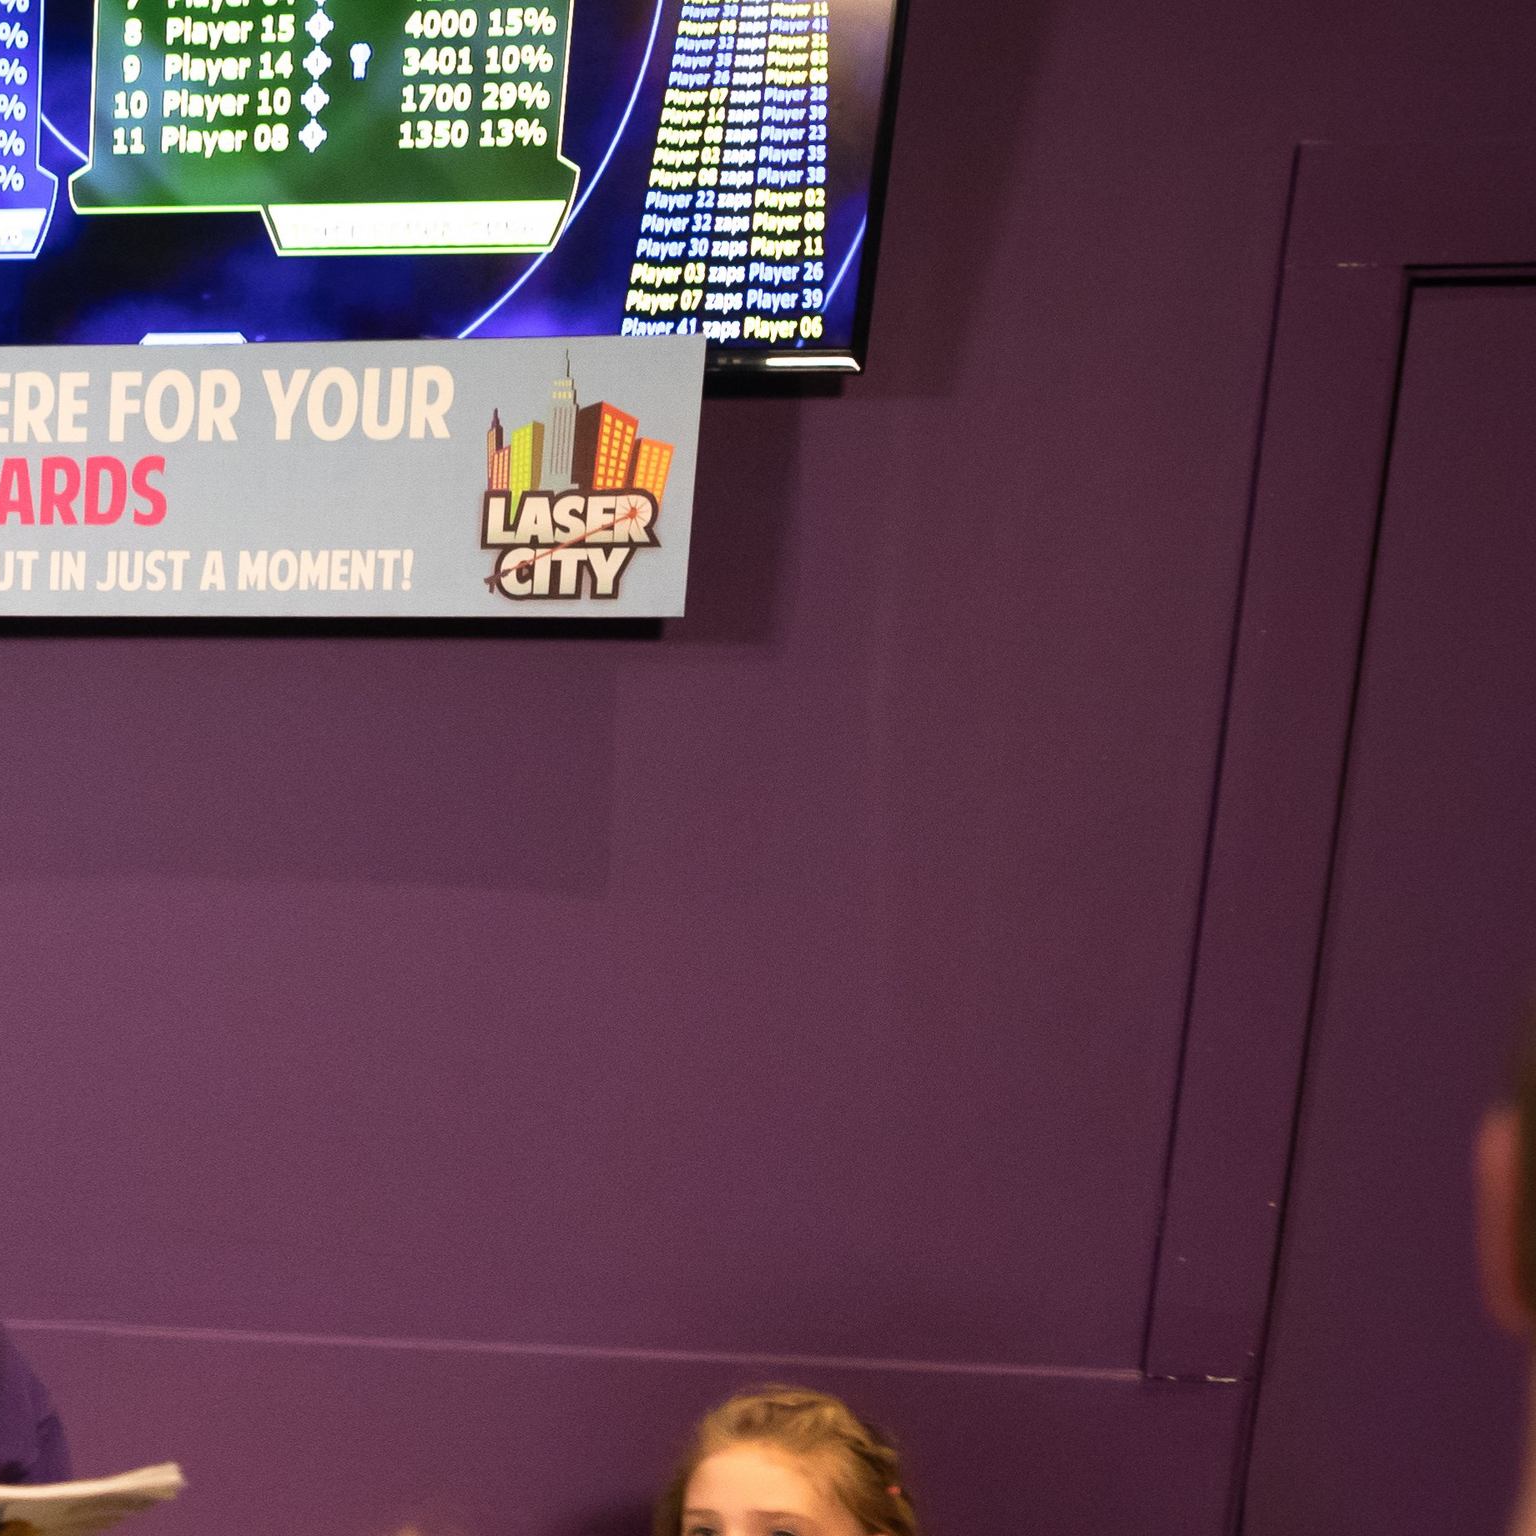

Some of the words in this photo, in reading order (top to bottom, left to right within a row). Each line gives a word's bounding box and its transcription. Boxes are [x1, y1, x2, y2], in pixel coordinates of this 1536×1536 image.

[125, 18, 141, 46] 8
[167, 16, 253, 50] Player
[261, 14, 294, 42] 15
[405, 9, 477, 38] 4000
[489, 8, 556, 36] 15%
[123, 55, 140, 83] 9
[165, 53, 251, 86] Player
[260, 51, 293, 79] 14
[403, 47, 472, 75] 3401
[486, 45, 553, 73] 10%
[115, 91, 147, 118] 10
[164, 89, 249, 122] Player
[258, 87, 290, 115] 10
[402, 83, 471, 112] 1700
[482, 82, 549, 110] 29%
[665, 89, 708, 108] Player
[710, 88, 728, 104] 07
[764, 87, 807, 104] Player
[661, 108, 705, 127] Player
[708, 107, 725, 123] 14
[763, 106, 806, 124] Player
[113, 127, 145, 154] 11
[162, 125, 247, 158] Player
[255, 124, 288, 151] 08
[399, 120, 468, 148] 1350
[480, 119, 547, 146] 13%
[657, 127, 702, 147] Player
[761, 126, 805, 144] Player
[809, 125, 826, 140] 23
[653, 147, 699, 168] Player
[701, 147, 720, 164] 02
[759, 146, 804, 165] Player
[808, 145, 826, 161] 35
[649, 168, 696, 190] Player
[758, 167, 803, 187] Player
[807, 167, 825, 183] 38
[646, 191, 692, 211] Player
[696, 191, 714, 207] 22
[717, 193, 752, 211] zaps
[755, 189, 803, 211] Player
[805, 188, 825, 207] 02
[641, 214, 689, 235] Player
[692, 214, 711, 231] 32
[714, 216, 749, 235] zaps
[753, 212, 802, 235] Player
[804, 211, 824, 231] 08
[637, 238, 686, 261] Player
[688, 238, 708, 256] 30
[712, 241, 747, 261] zaps
[751, 236, 801, 260] Player
[804, 236, 823, 255] 11
[631, 263, 682, 288] Player
[684, 263, 705, 283] 03
[708, 266, 745, 287] zaps
[749, 262, 799, 285] Player
[804, 262, 823, 280] 26
[626, 289, 678, 315] Player
[681, 289, 702, 310] 07
[705, 293, 742, 314] zaps
[747, 289, 798, 313] Player
[802, 289, 822, 308] 39
[621, 318, 674, 336] Player
[677, 318, 697, 335] 41
[703, 321, 740, 343] zaps
[744, 316, 797, 343] Player
[800, 316, 822, 338] 06
[108, 368, 241, 443] FOR
[262, 363, 454, 441] YOUR
[486, 494, 653, 544] LASER
[49, 550, 86, 591] IN
[96, 548, 190, 592] JUST
[199, 549, 225, 591] A
[237, 548, 415, 592] MOMENT!
[499, 546, 630, 597] CITY
